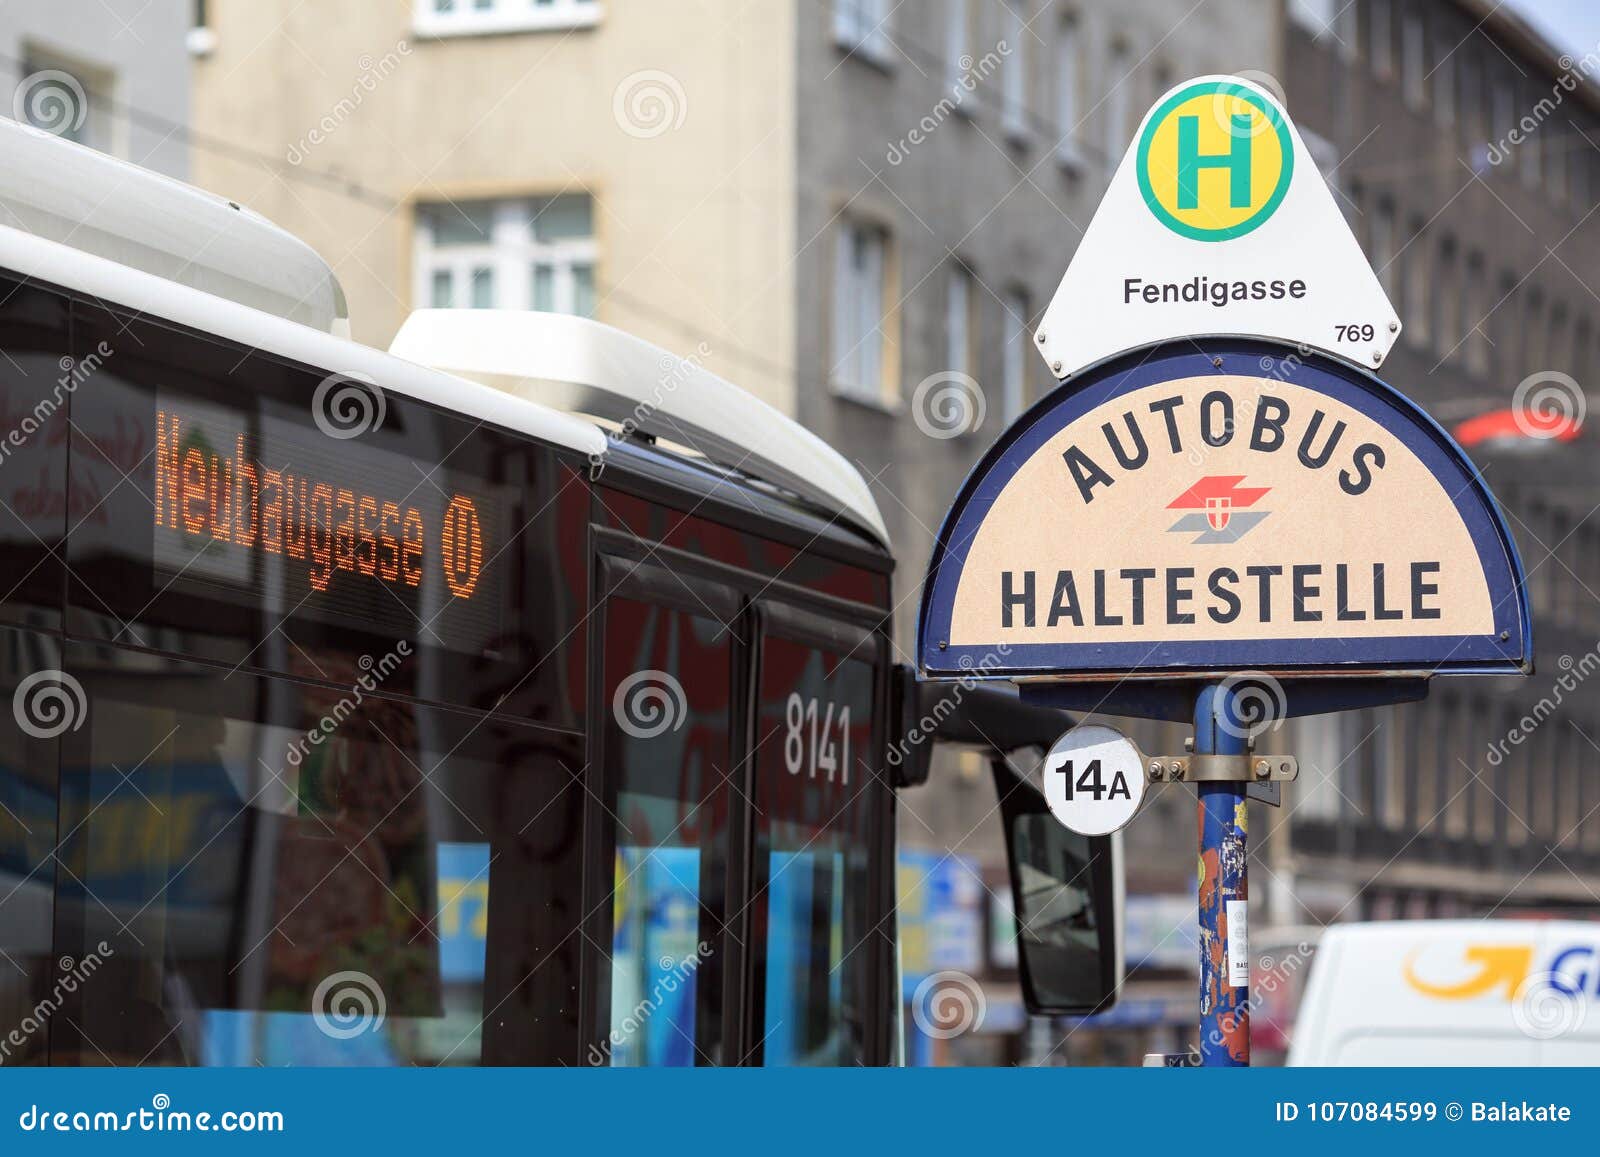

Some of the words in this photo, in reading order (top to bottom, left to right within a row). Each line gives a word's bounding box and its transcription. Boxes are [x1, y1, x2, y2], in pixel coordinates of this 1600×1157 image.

[1177, 114, 1252, 209] H
[1123, 276, 1307, 306] Fendigasse
[1334, 324, 1375, 342] 769
[1062, 390, 1386, 505] AUTOBUS
[154, 410, 423, 592] Neubaugasse
[1001, 562, 1441, 628] HALTESTELLE
[784, 691, 851, 786] 8141
[1055, 760, 1132, 801] 14A
